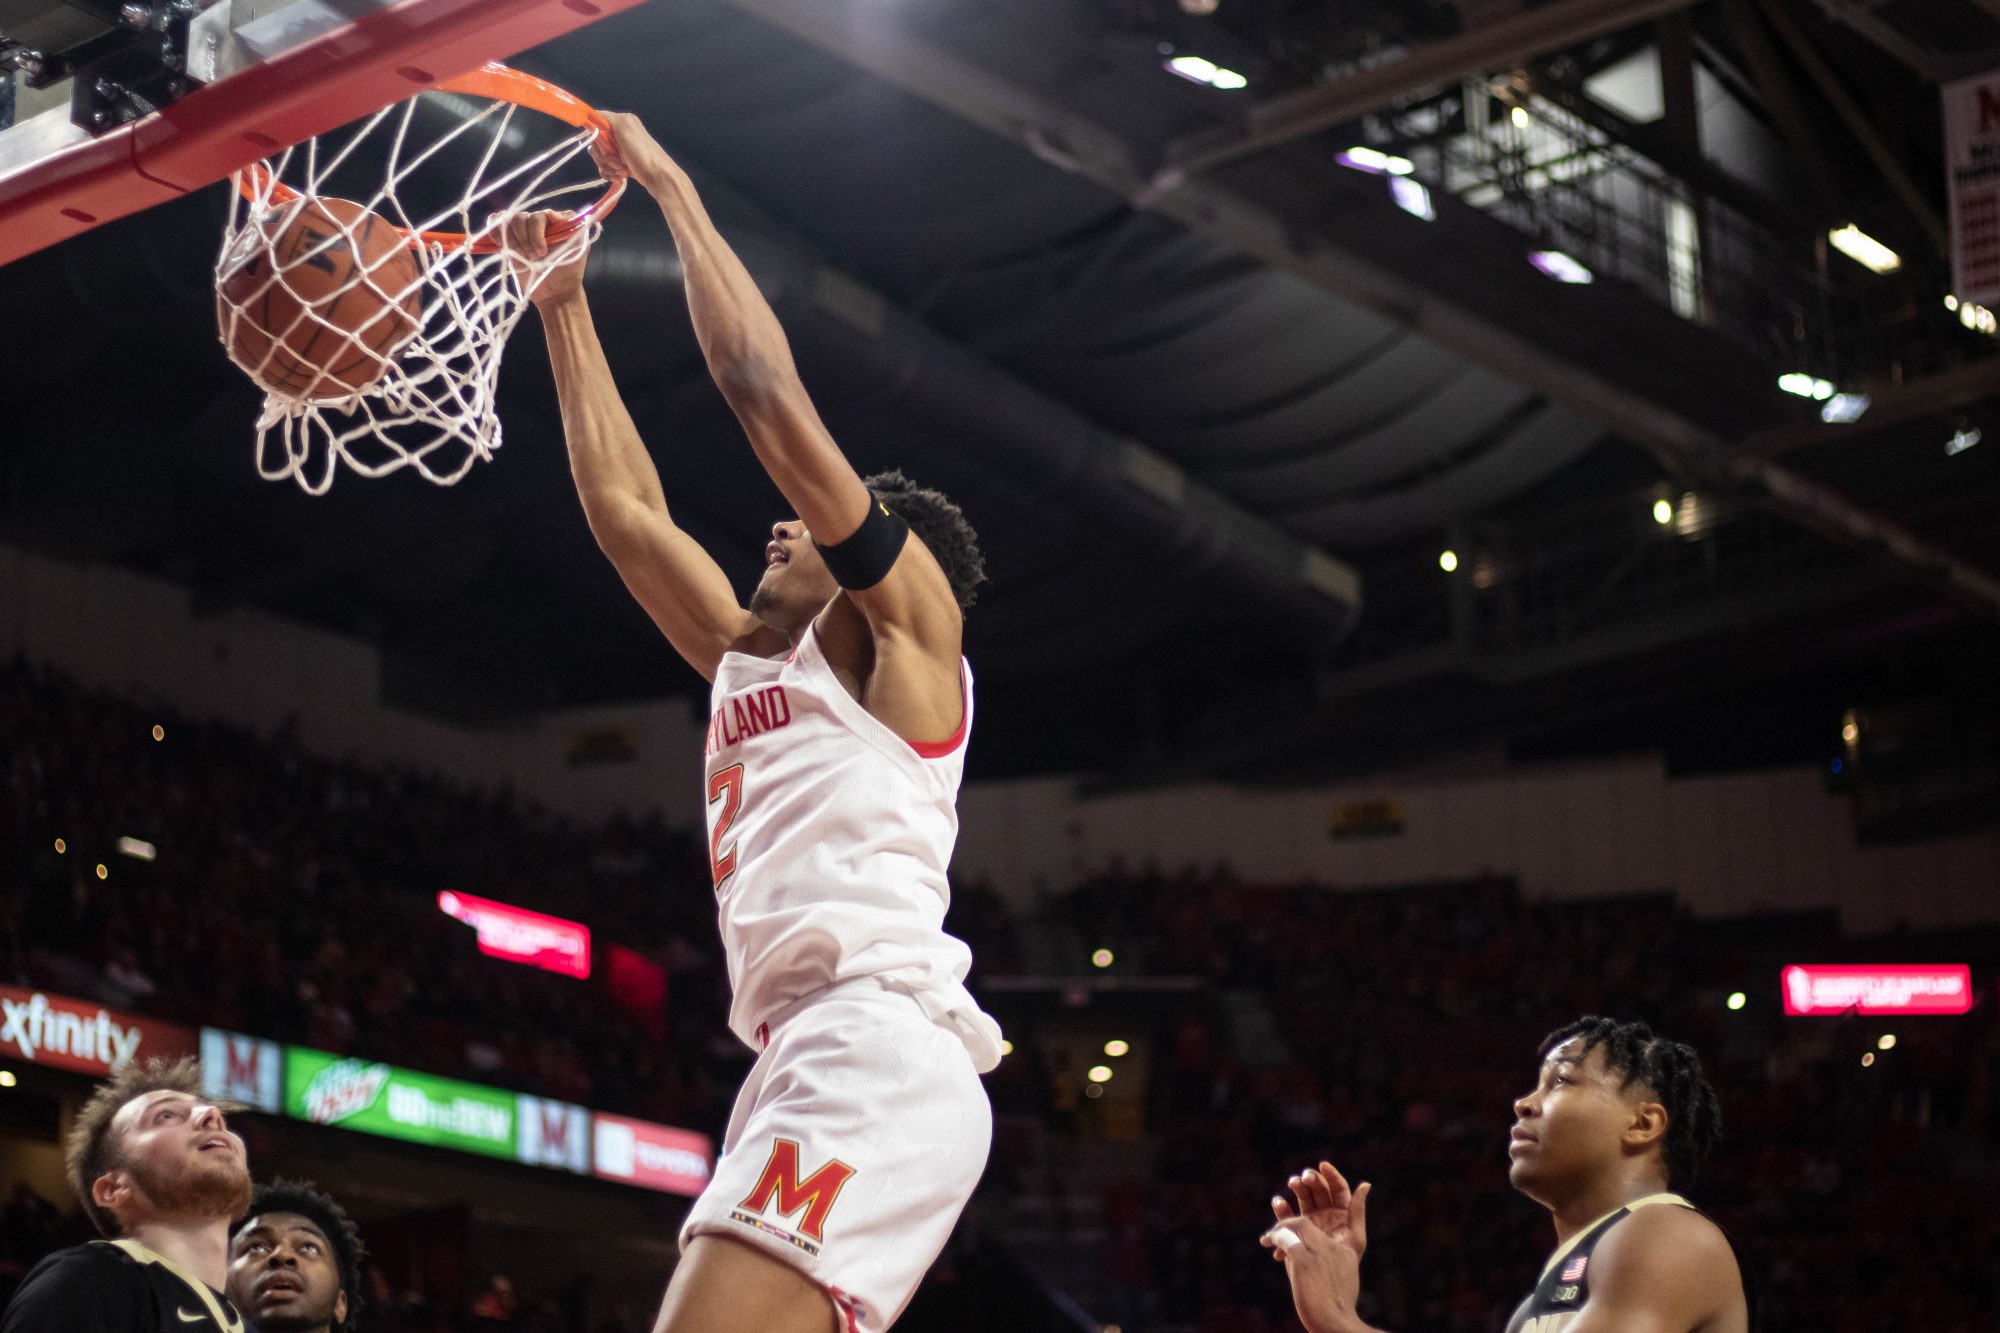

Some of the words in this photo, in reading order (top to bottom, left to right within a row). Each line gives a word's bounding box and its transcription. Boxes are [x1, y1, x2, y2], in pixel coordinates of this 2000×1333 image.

[709, 763, 745, 891] 2
[1, 993, 142, 1076] xfinity
[737, 1137, 857, 1243] M
